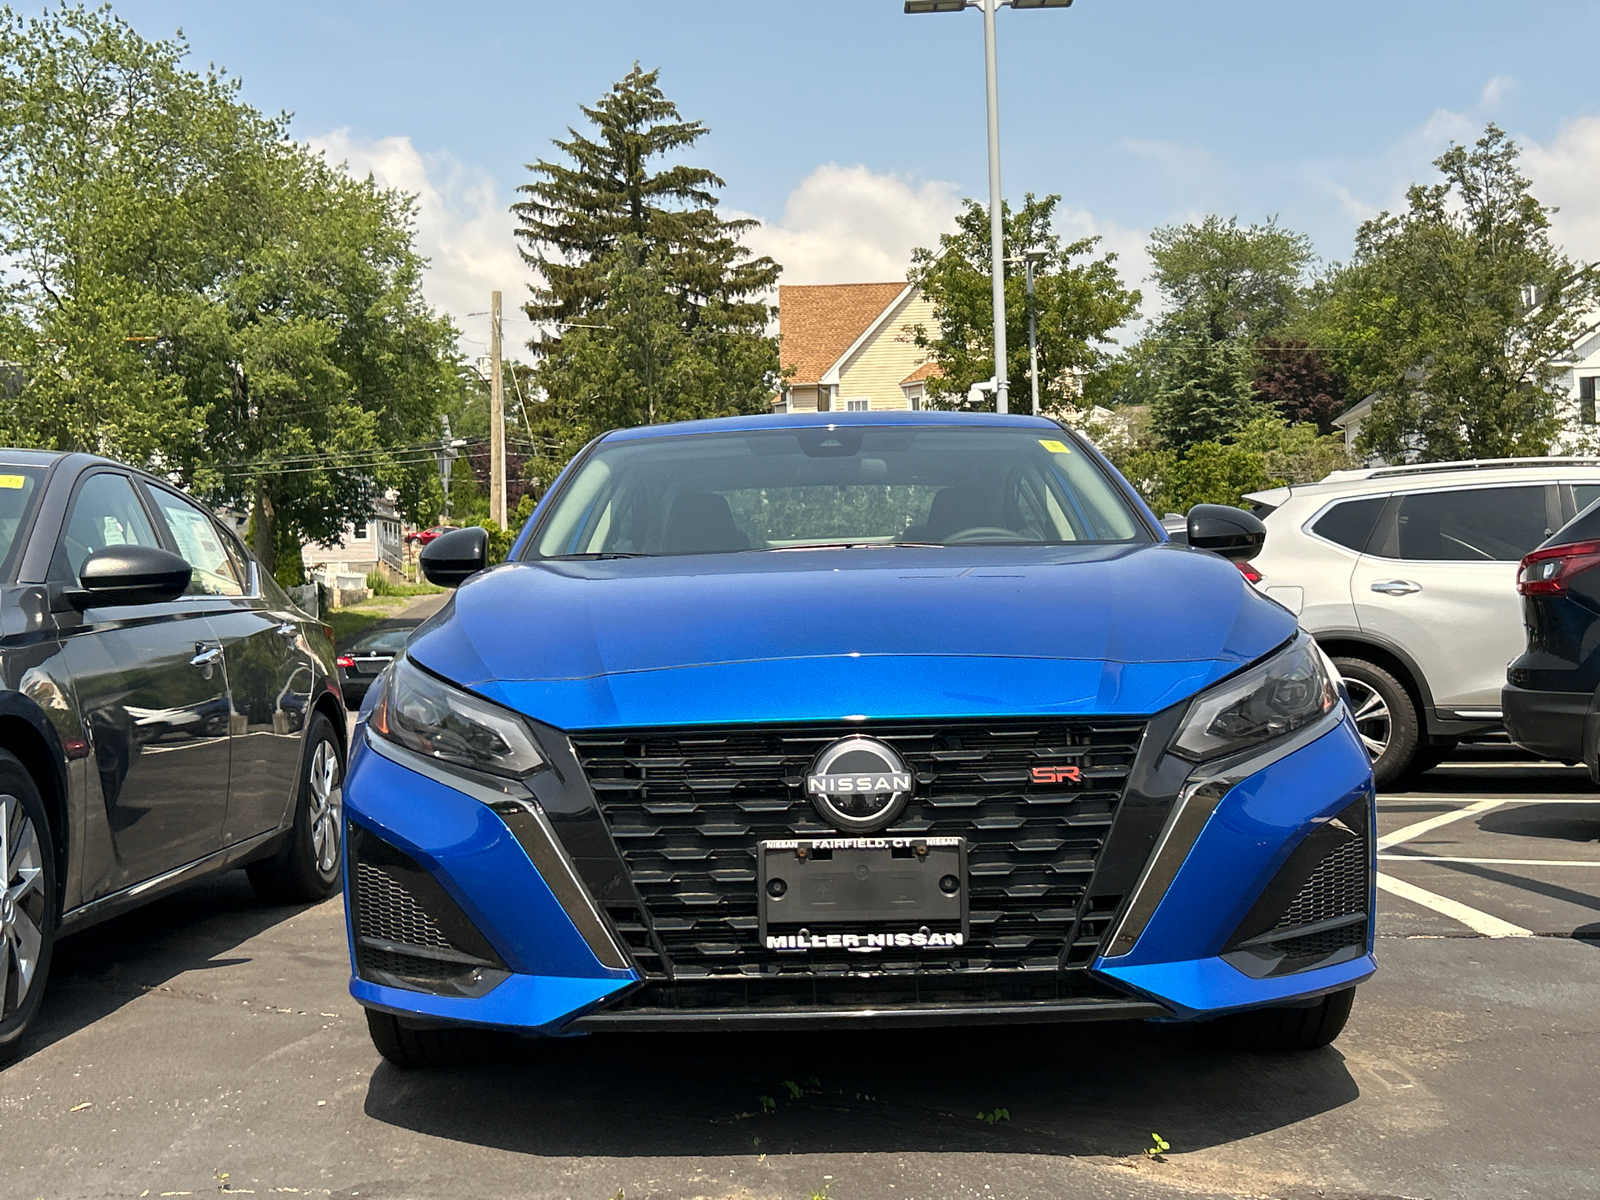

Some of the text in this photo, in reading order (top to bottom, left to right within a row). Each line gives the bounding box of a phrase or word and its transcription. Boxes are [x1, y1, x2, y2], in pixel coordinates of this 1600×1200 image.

[1032, 766, 1081, 783] SR
[810, 775, 910, 792] NISSAN
[766, 841, 798, 849] NISSAN
[812, 839, 912, 849] FAIRFIELD, CT
[926, 838, 959, 846] NISSAN
[766, 933, 964, 948] MILLER NISSAN
